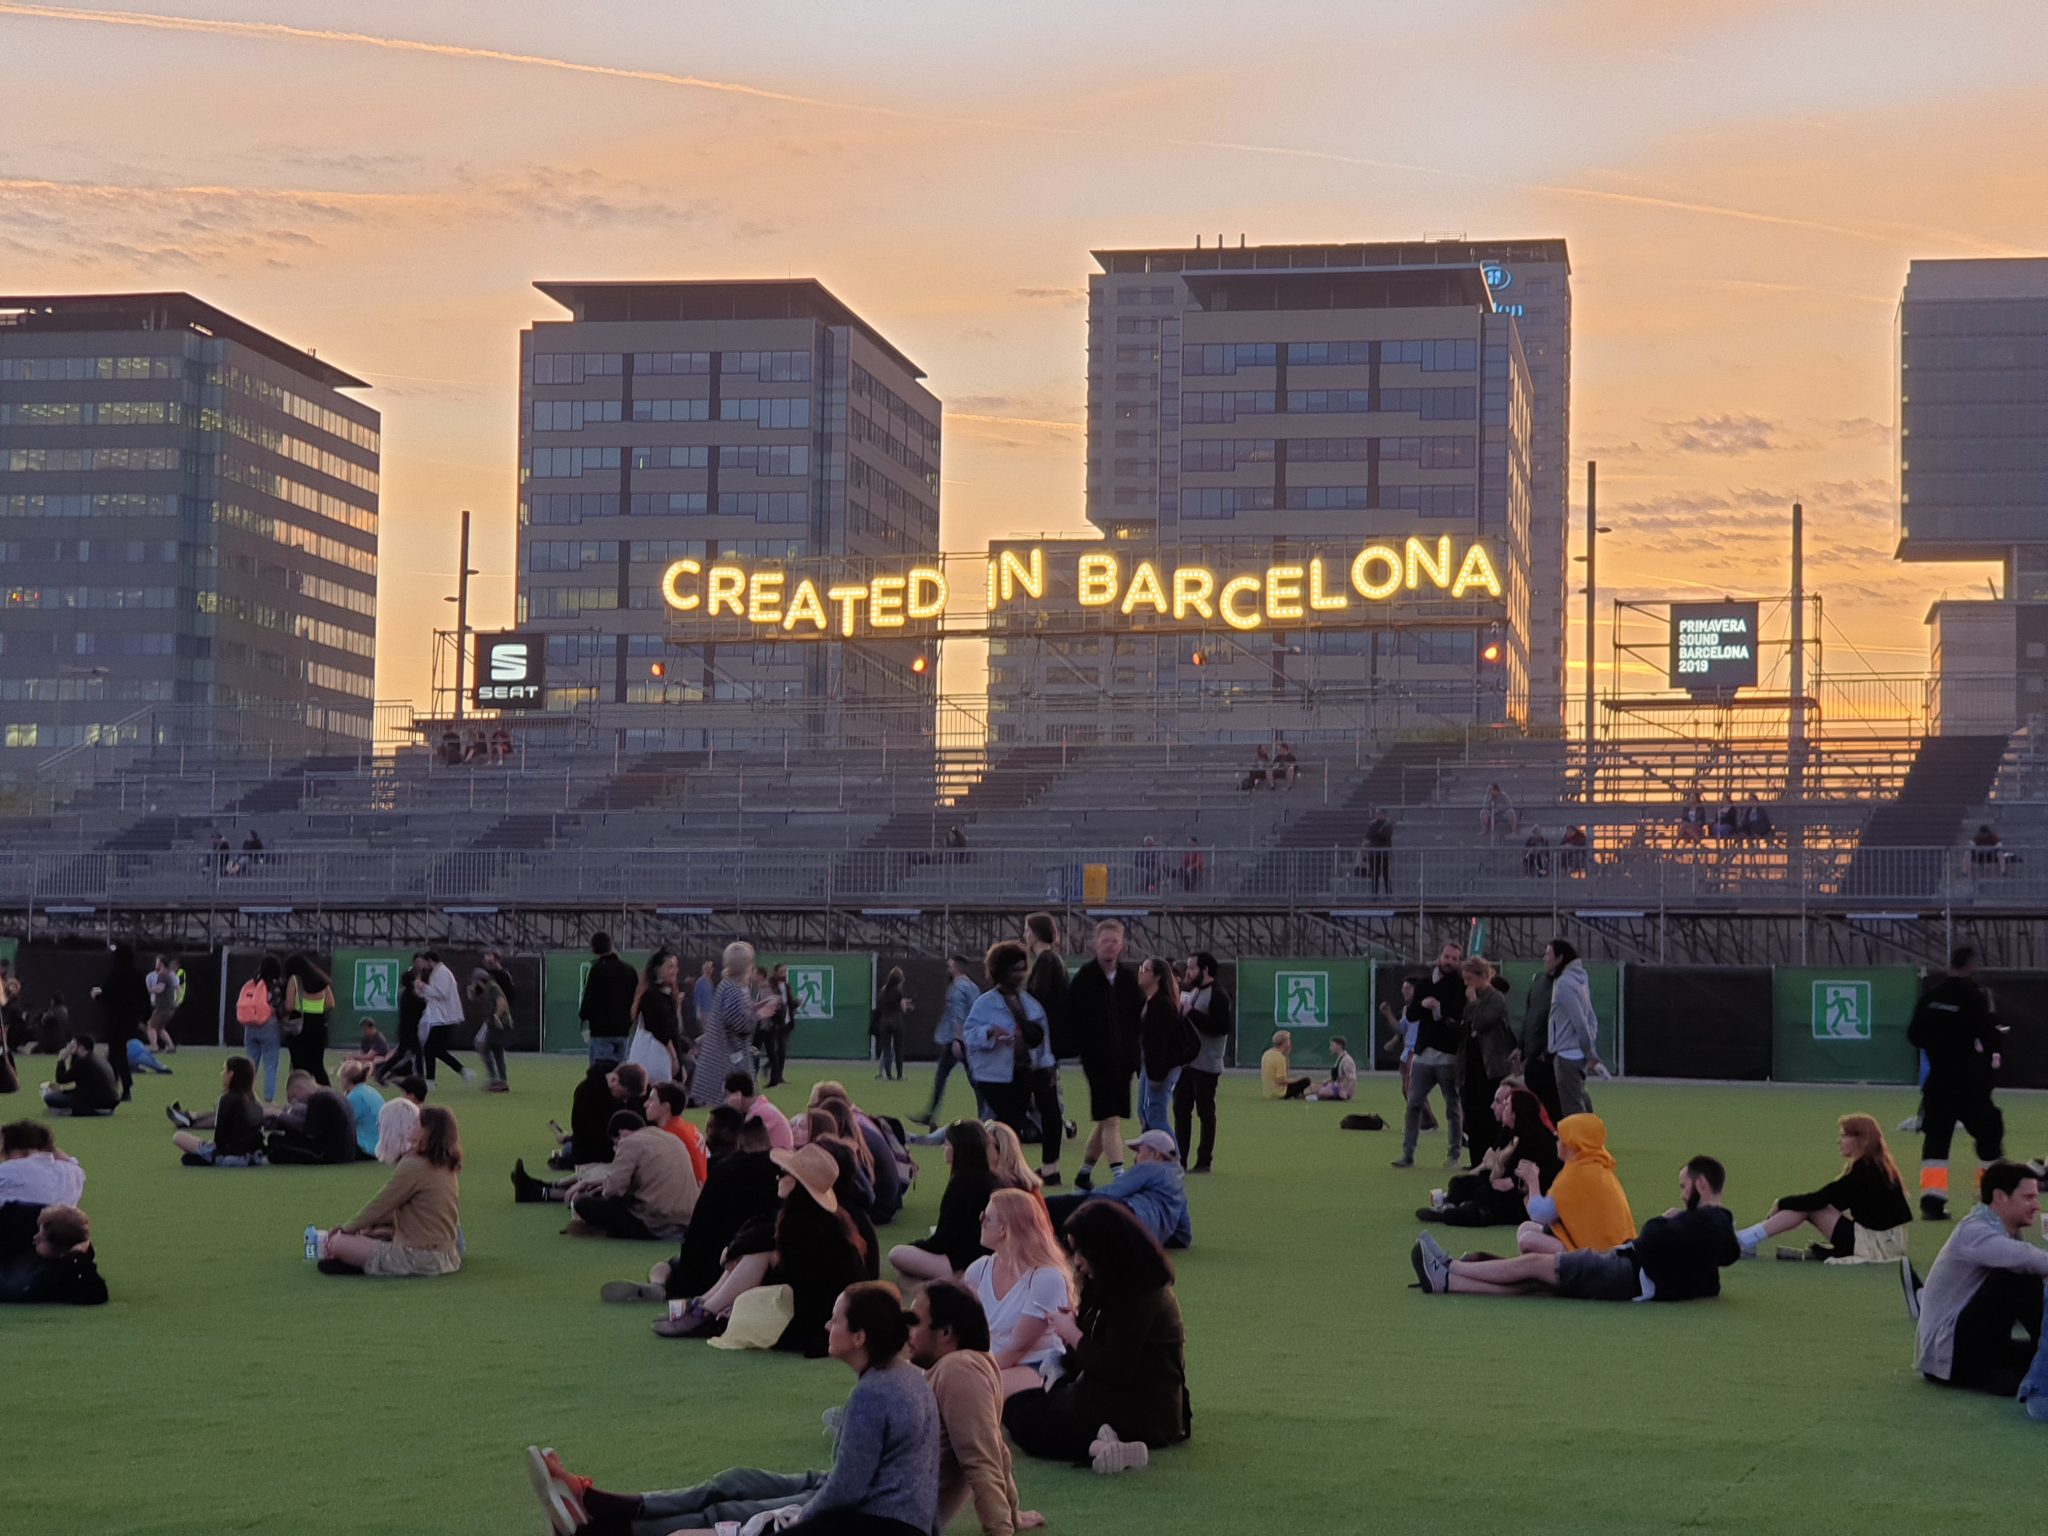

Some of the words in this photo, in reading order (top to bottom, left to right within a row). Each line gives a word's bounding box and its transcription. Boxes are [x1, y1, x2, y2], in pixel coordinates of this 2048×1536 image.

[662, 559, 949, 637] CREATED
[986, 548, 1042, 611] IN
[1078, 535, 1501, 629] BARCELONA
[1679, 619, 1746, 633] PRIMAVERA
[1679, 633, 1719, 646] SOUND
[1679, 645, 1749, 659] BARCELONA
[1678, 659, 1709, 673] 2019
[478, 685, 539, 699] SEAT
